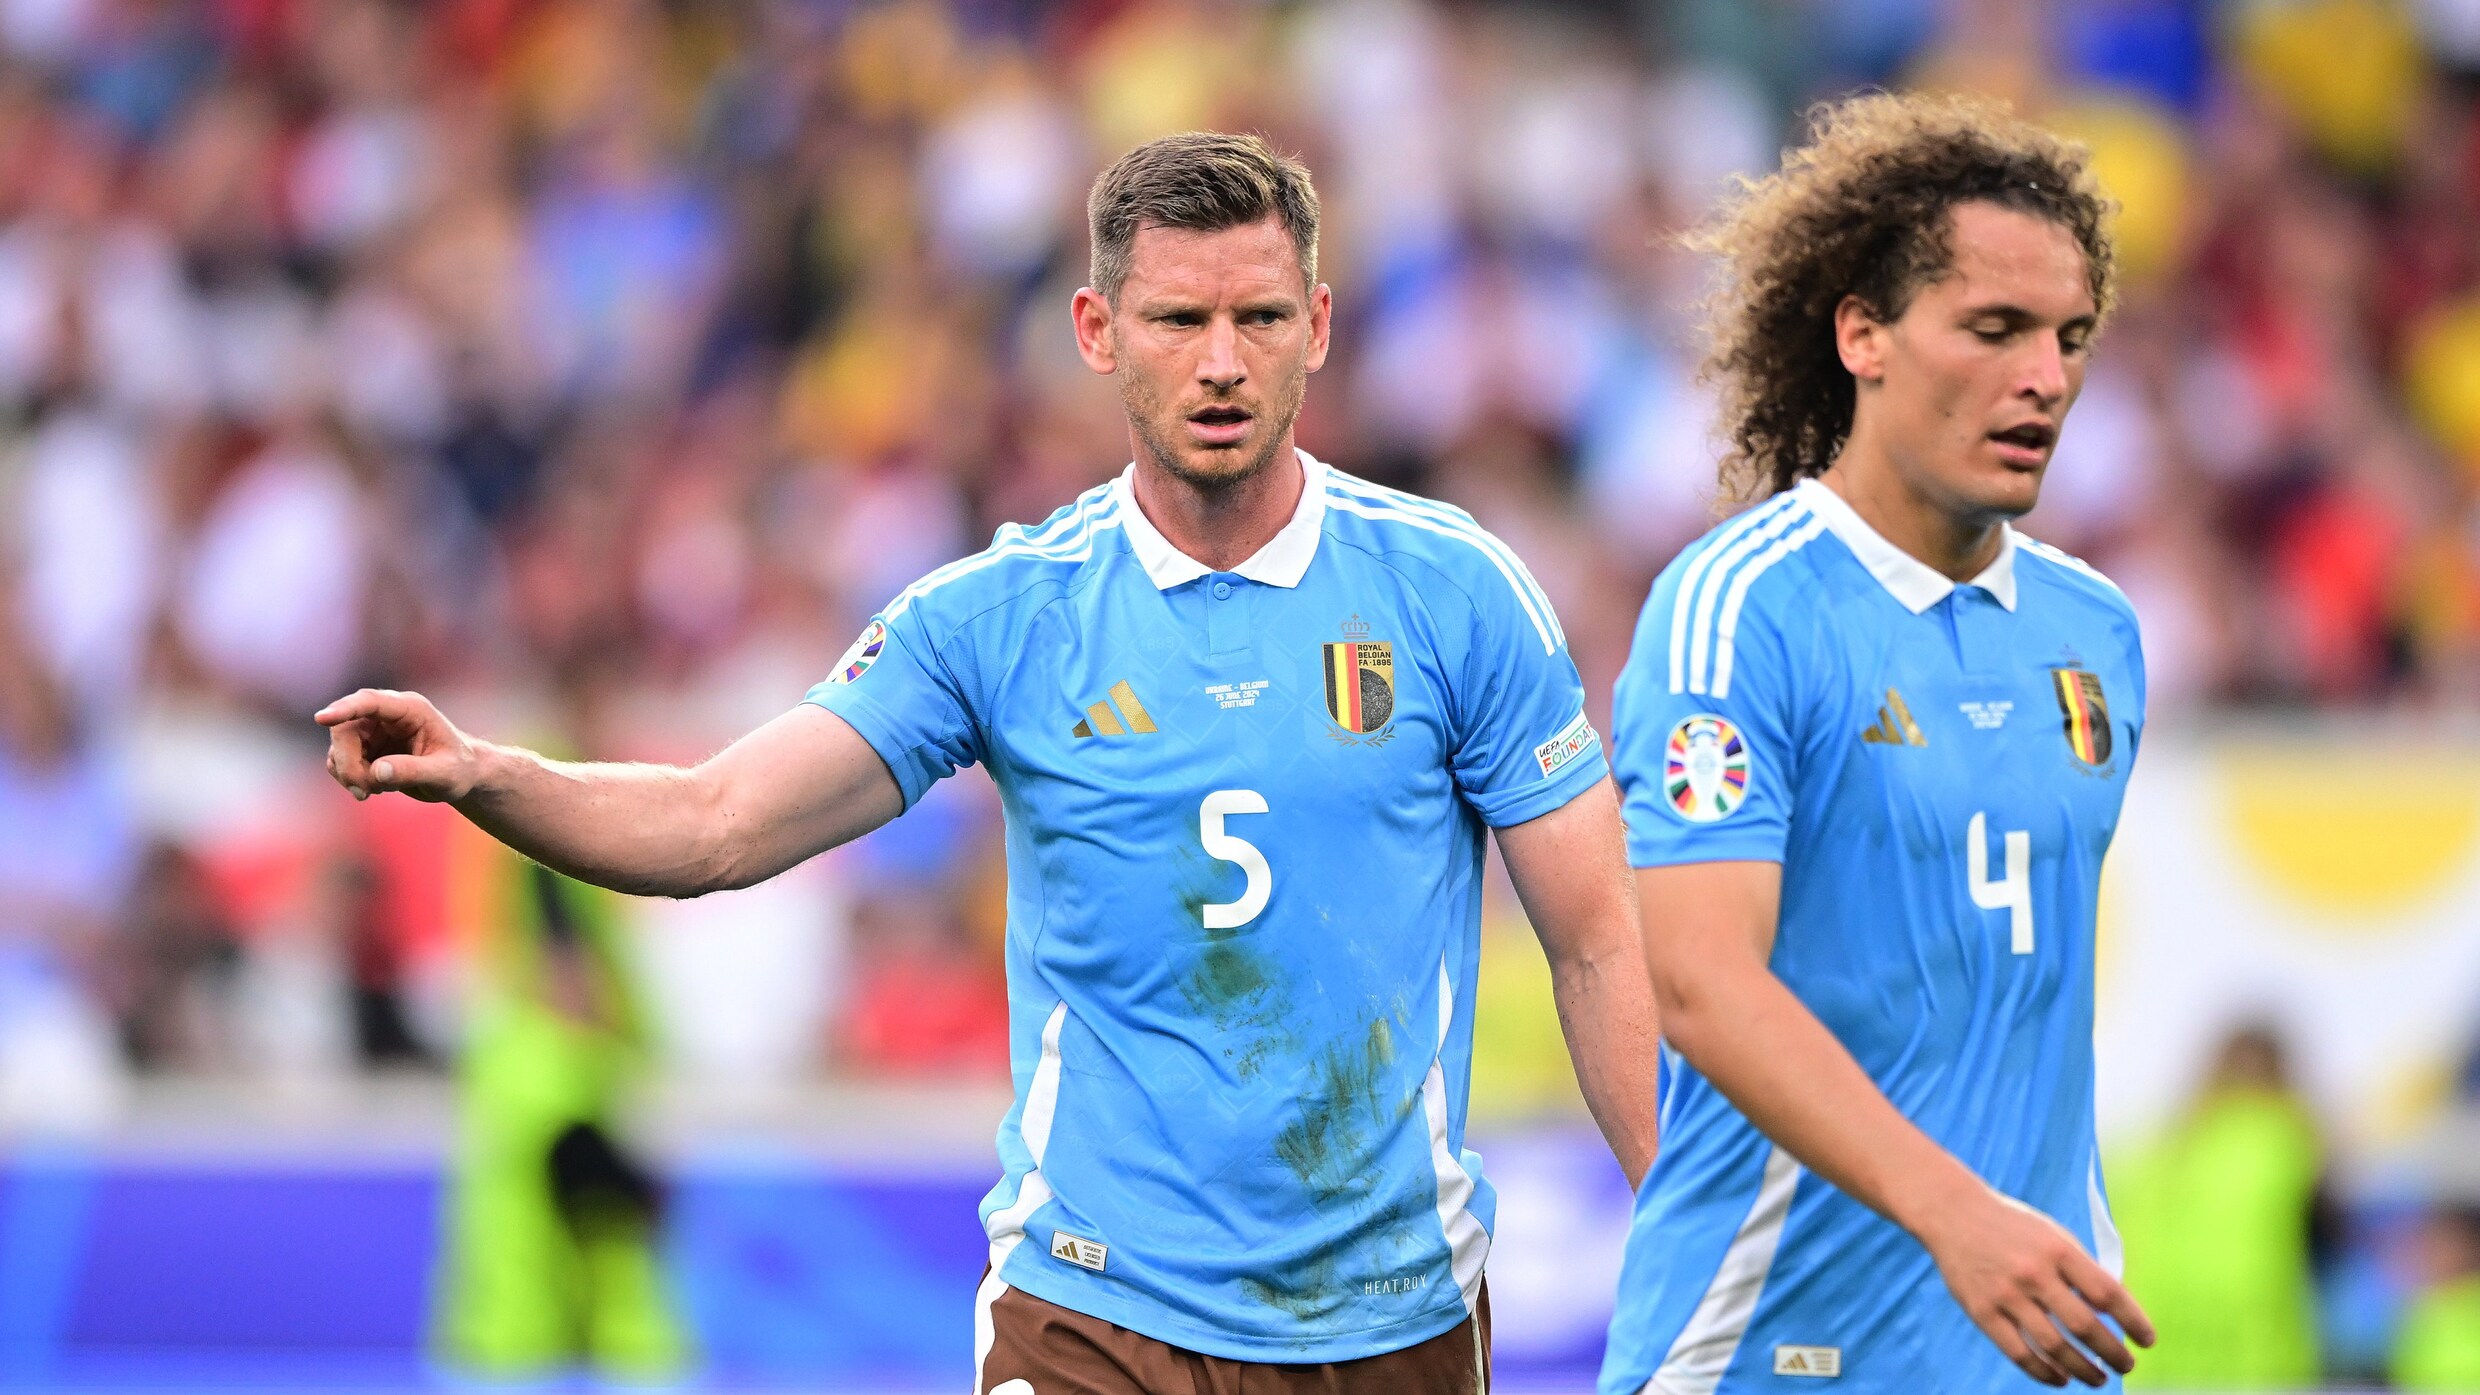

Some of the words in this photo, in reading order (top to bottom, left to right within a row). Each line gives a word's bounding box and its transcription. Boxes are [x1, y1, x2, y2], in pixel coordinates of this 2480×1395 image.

[1358, 651, 1391, 659] BELGIAN
[1215, 693, 1224, 701] 26
[1242, 690, 1260, 699] 2024
[1539, 740, 1561, 758] UEFA
[1200, 789, 1272, 929] 5
[1967, 810, 2034, 955] 4
